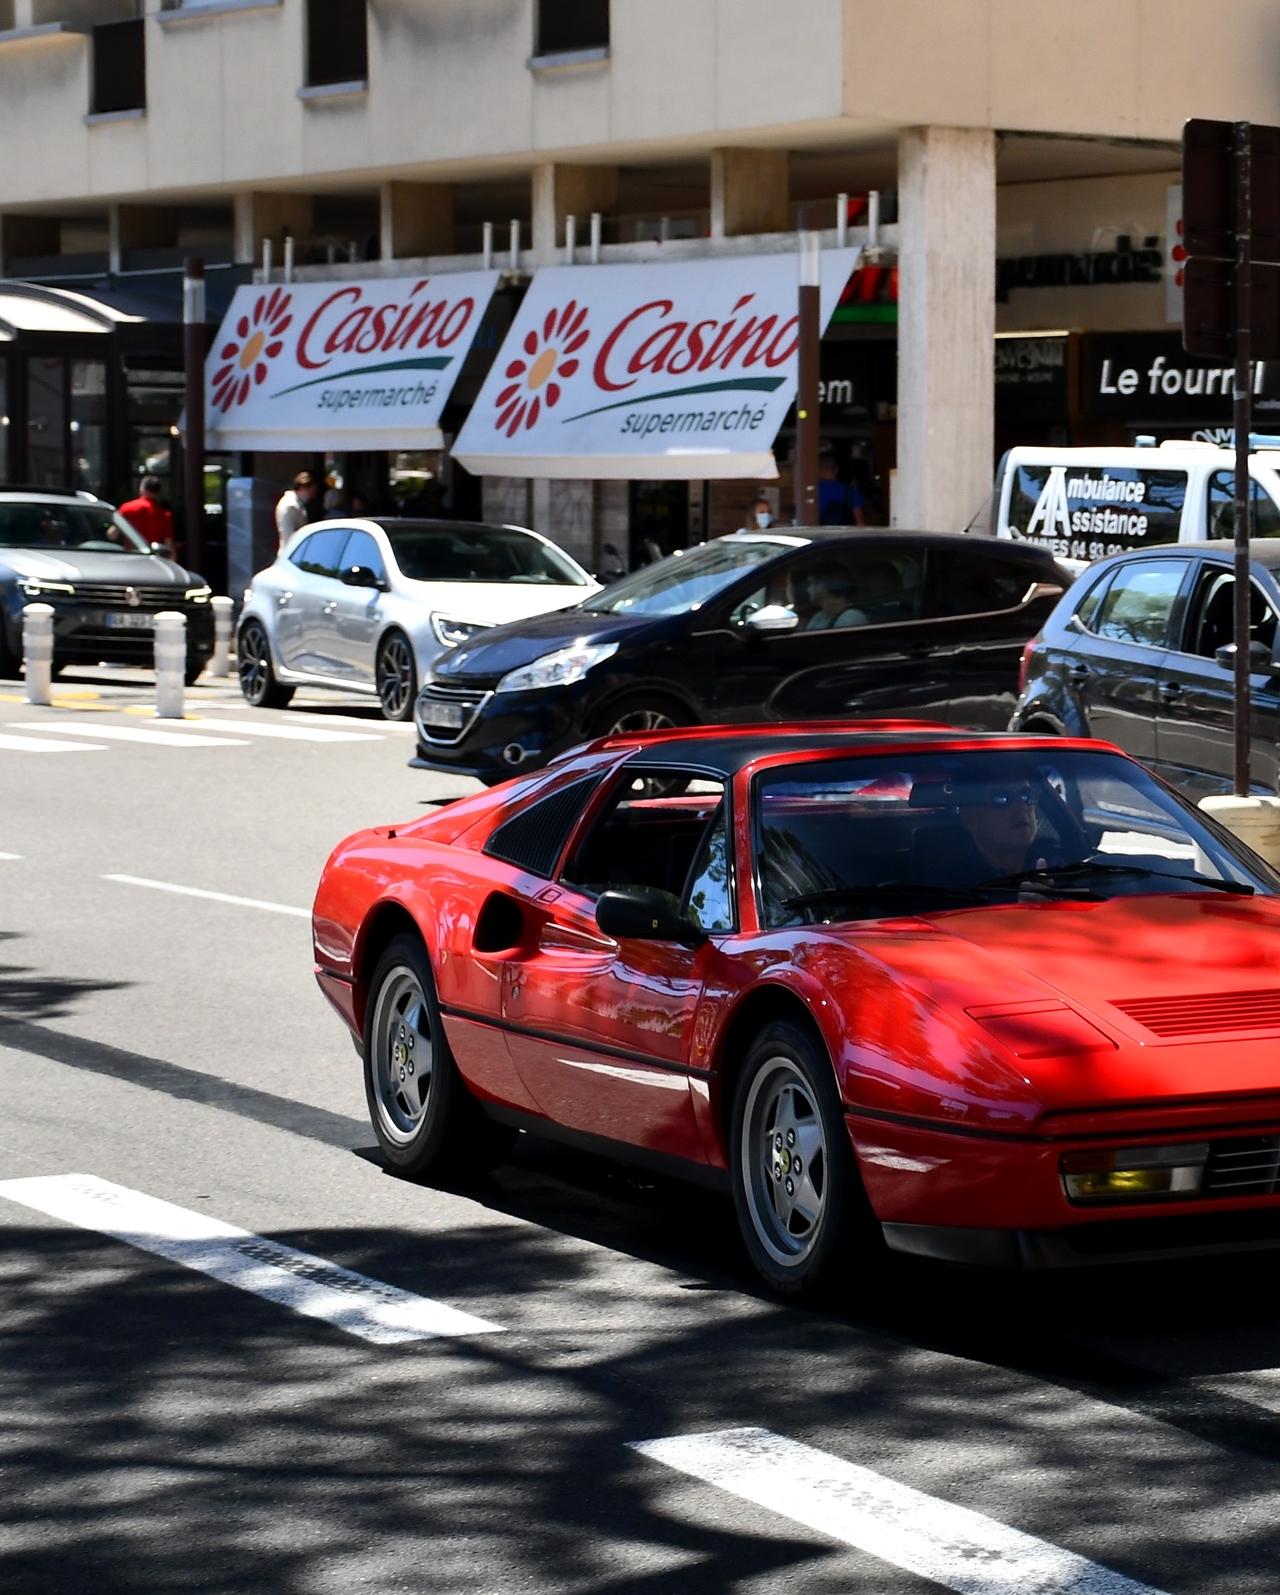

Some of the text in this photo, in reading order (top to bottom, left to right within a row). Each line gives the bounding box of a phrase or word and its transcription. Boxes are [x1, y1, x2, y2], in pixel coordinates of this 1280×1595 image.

[296, 279, 475, 370] Casino
[1100, 359, 1139, 394] Le
[317, 379, 438, 412] supermarché
[620, 403, 768, 439] supermarché
